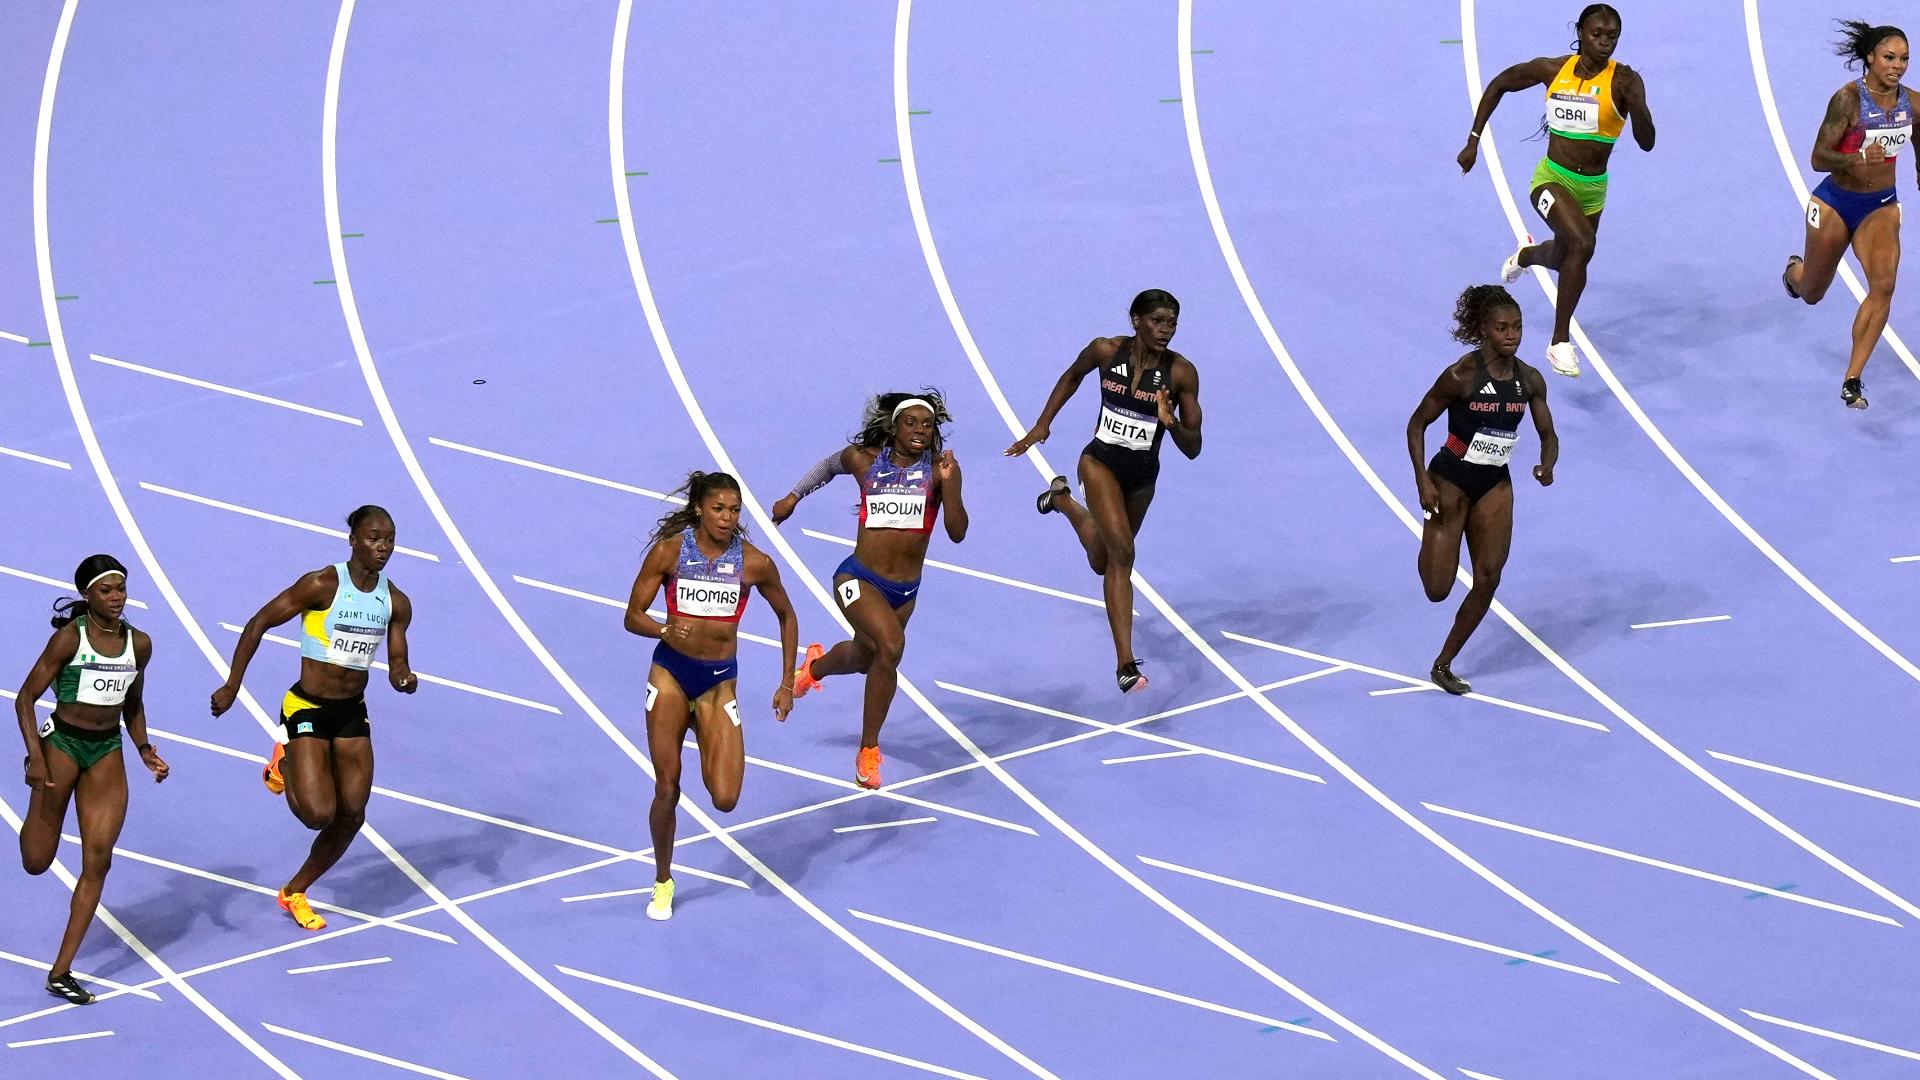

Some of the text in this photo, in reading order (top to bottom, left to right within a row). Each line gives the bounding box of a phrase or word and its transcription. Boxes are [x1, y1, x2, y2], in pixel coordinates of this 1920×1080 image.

[1554, 107, 1587, 122] GBAI
[1541, 198, 1549, 210] 3
[1811, 207, 1818, 222] 2
[1101, 378, 1128, 396] GREAT
[1469, 401, 1500, 413] GREAT
[1103, 415, 1148, 441] NEITA
[869, 501, 923, 516] BROWN
[678, 586, 738, 604] THOMAS
[846, 586, 853, 600] 6
[338, 610, 362, 620] SAINT
[93, 678, 126, 693] OFILI
